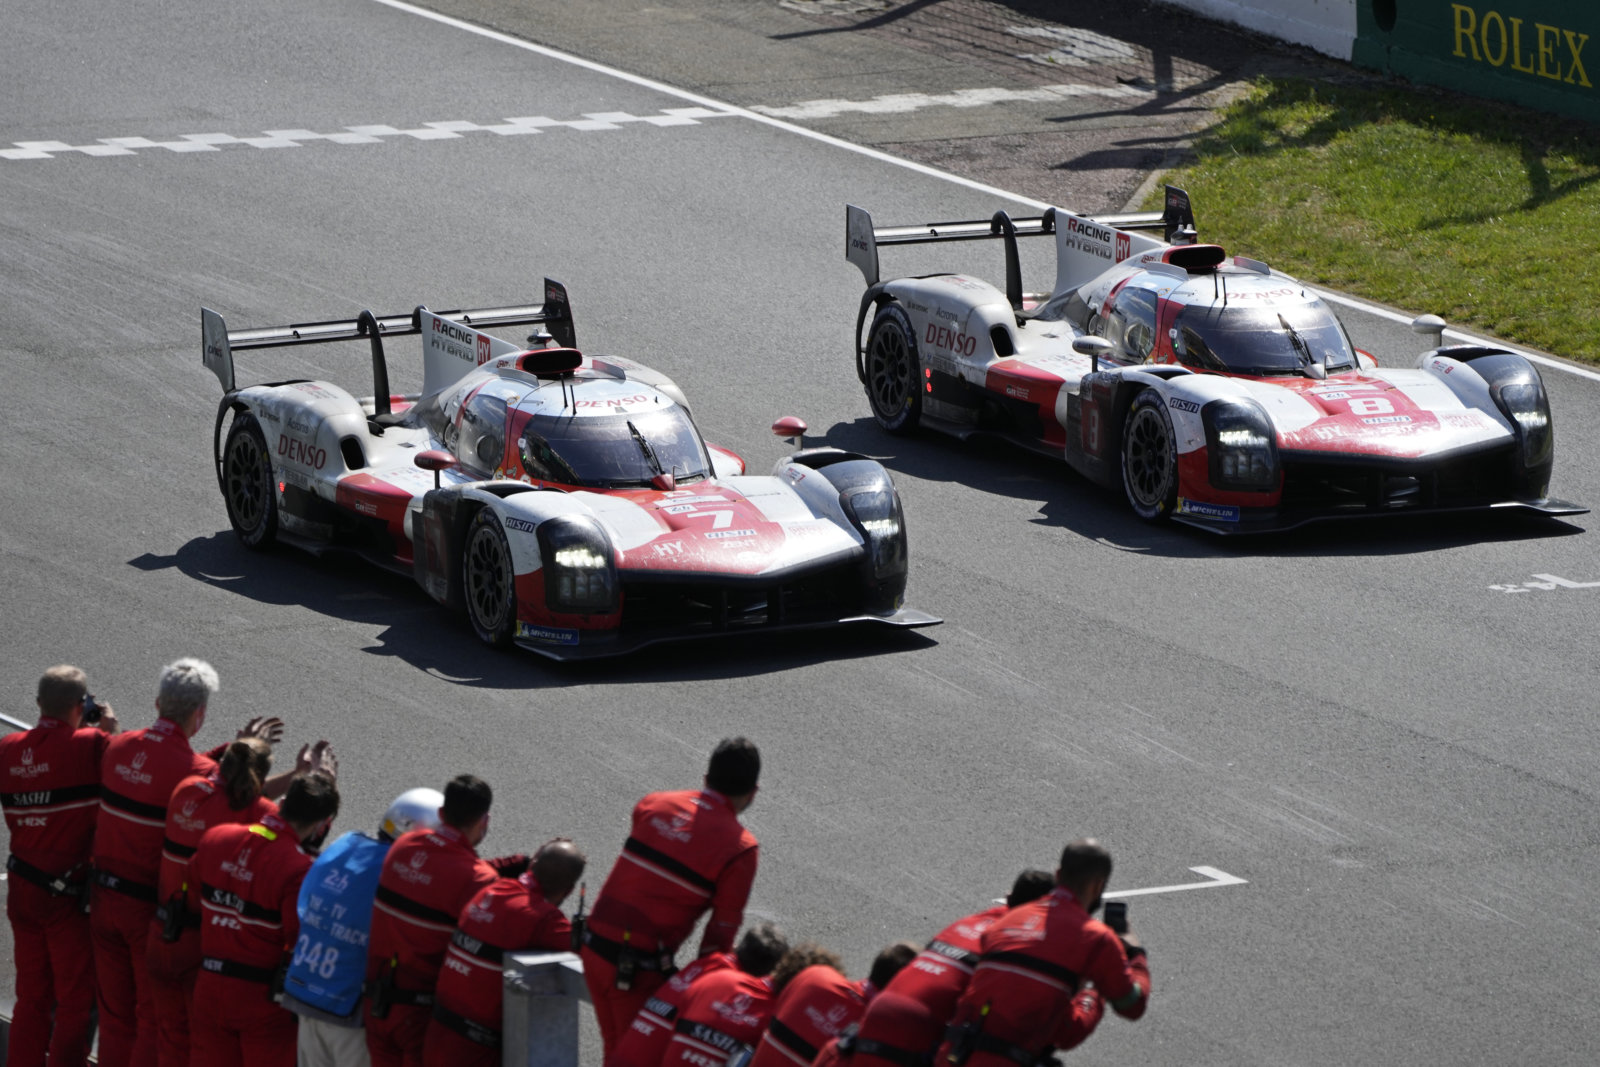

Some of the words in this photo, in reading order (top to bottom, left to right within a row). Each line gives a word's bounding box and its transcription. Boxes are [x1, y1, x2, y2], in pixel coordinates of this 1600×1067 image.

[1451, 3, 1593, 88] ROLEX
[1068, 217, 1111, 242] RACING
[1066, 233, 1112, 259] HYBRID
[1116, 238, 1130, 262] HY
[1225, 288, 1294, 299] DENSO
[432, 317, 473, 346] RACING
[925, 323, 977, 357] DENSO
[431, 334, 474, 362] HYBRID
[477, 342, 490, 363] HY
[575, 395, 648, 408] DENSO
[1171, 398, 1200, 413] AISIN
[1347, 397, 1395, 415] 8
[1313, 425, 1345, 440] HY
[278, 434, 326, 470] DENSO
[686, 510, 734, 530] 7
[1191, 504, 1233, 517] MICHELIN
[506, 517, 535, 532] AISIN
[653, 541, 684, 556] HY
[530, 628, 573, 641] MICHELIN
[331, 903, 347, 920] TV
[330, 922, 369, 946] TRACK
